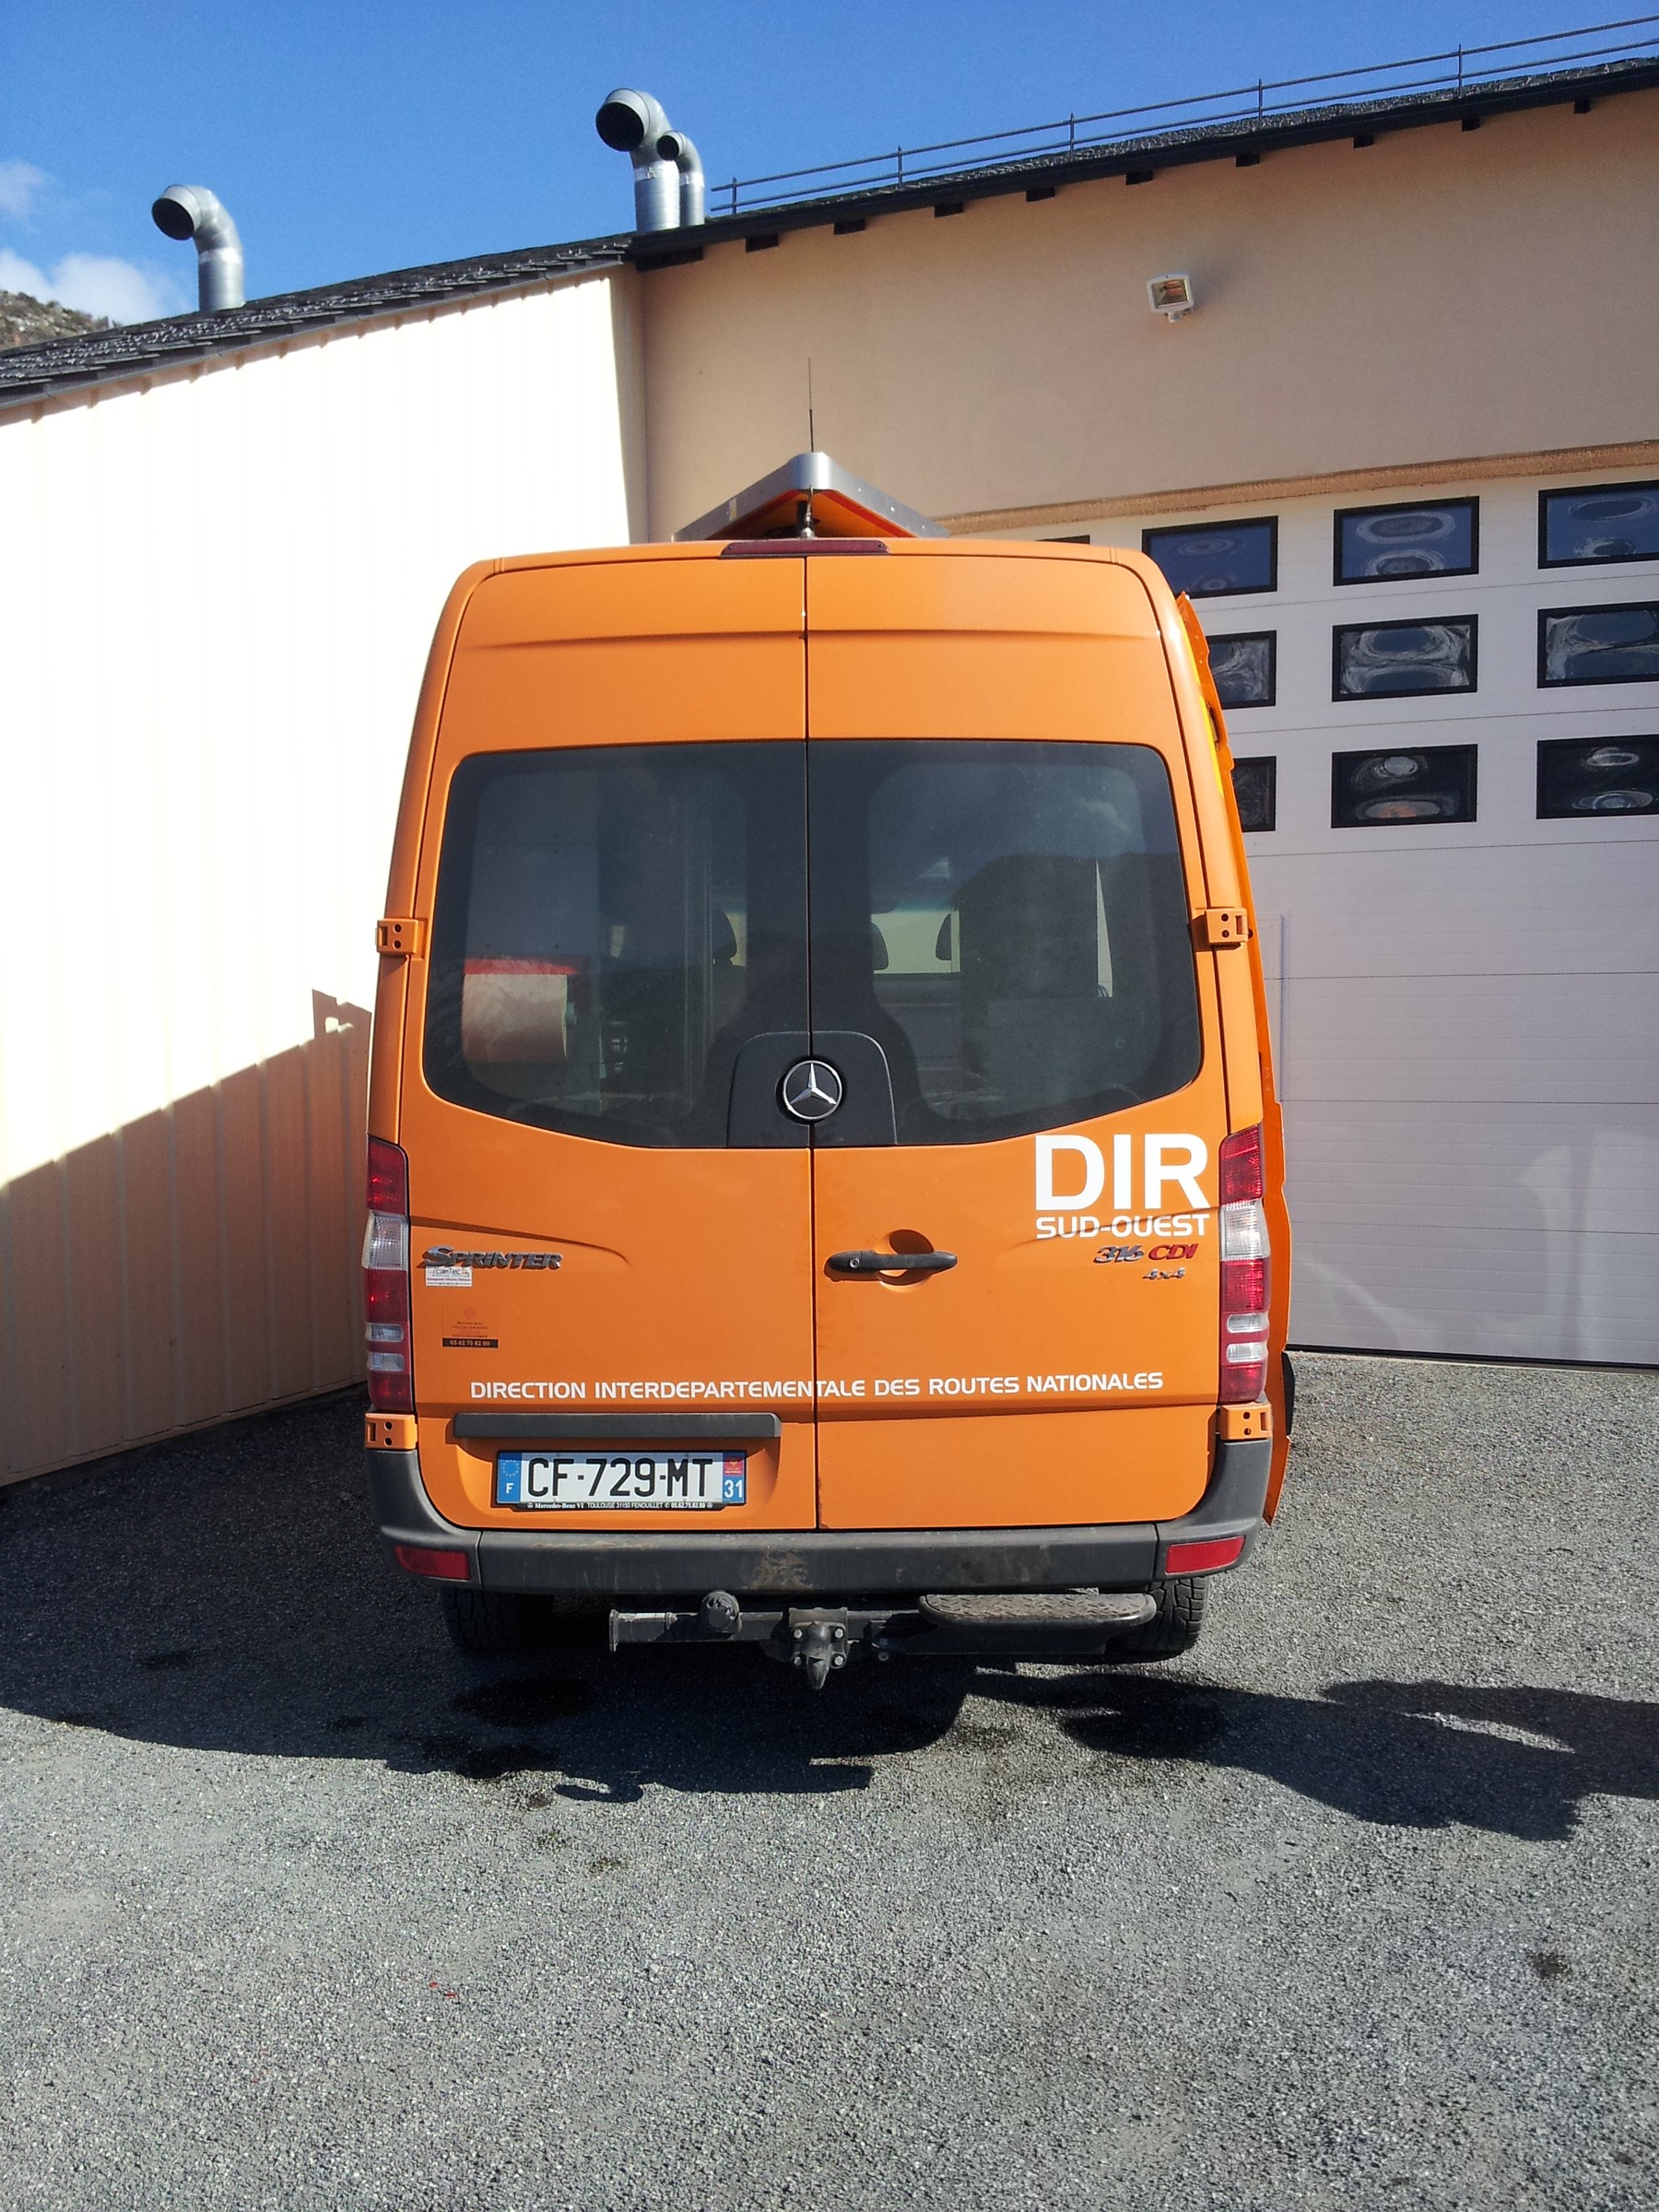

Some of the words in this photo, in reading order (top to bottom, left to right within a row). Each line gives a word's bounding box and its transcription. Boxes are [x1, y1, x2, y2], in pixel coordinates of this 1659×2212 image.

[1035, 1133, 1211, 1210] DIR
[1036, 1214, 1210, 1239] SUD-OUEST
[1094, 1245, 1144, 1264] 316
[1148, 1243, 1198, 1260] CDI
[1143, 1267, 1185, 1280] 4x4
[470, 1381, 586, 1399] DIRECTION
[594, 1379, 865, 1399] INTERDEPARTEMENTALE
[874, 1378, 921, 1397] DES
[929, 1376, 1020, 1395] ROUTES
[1027, 1371, 1164, 1393] NATIONALES
[506, 1482, 514, 1494] F
[528, 1457, 713, 1497] CF-729-MT
[724, 1479, 744, 1499] 31
